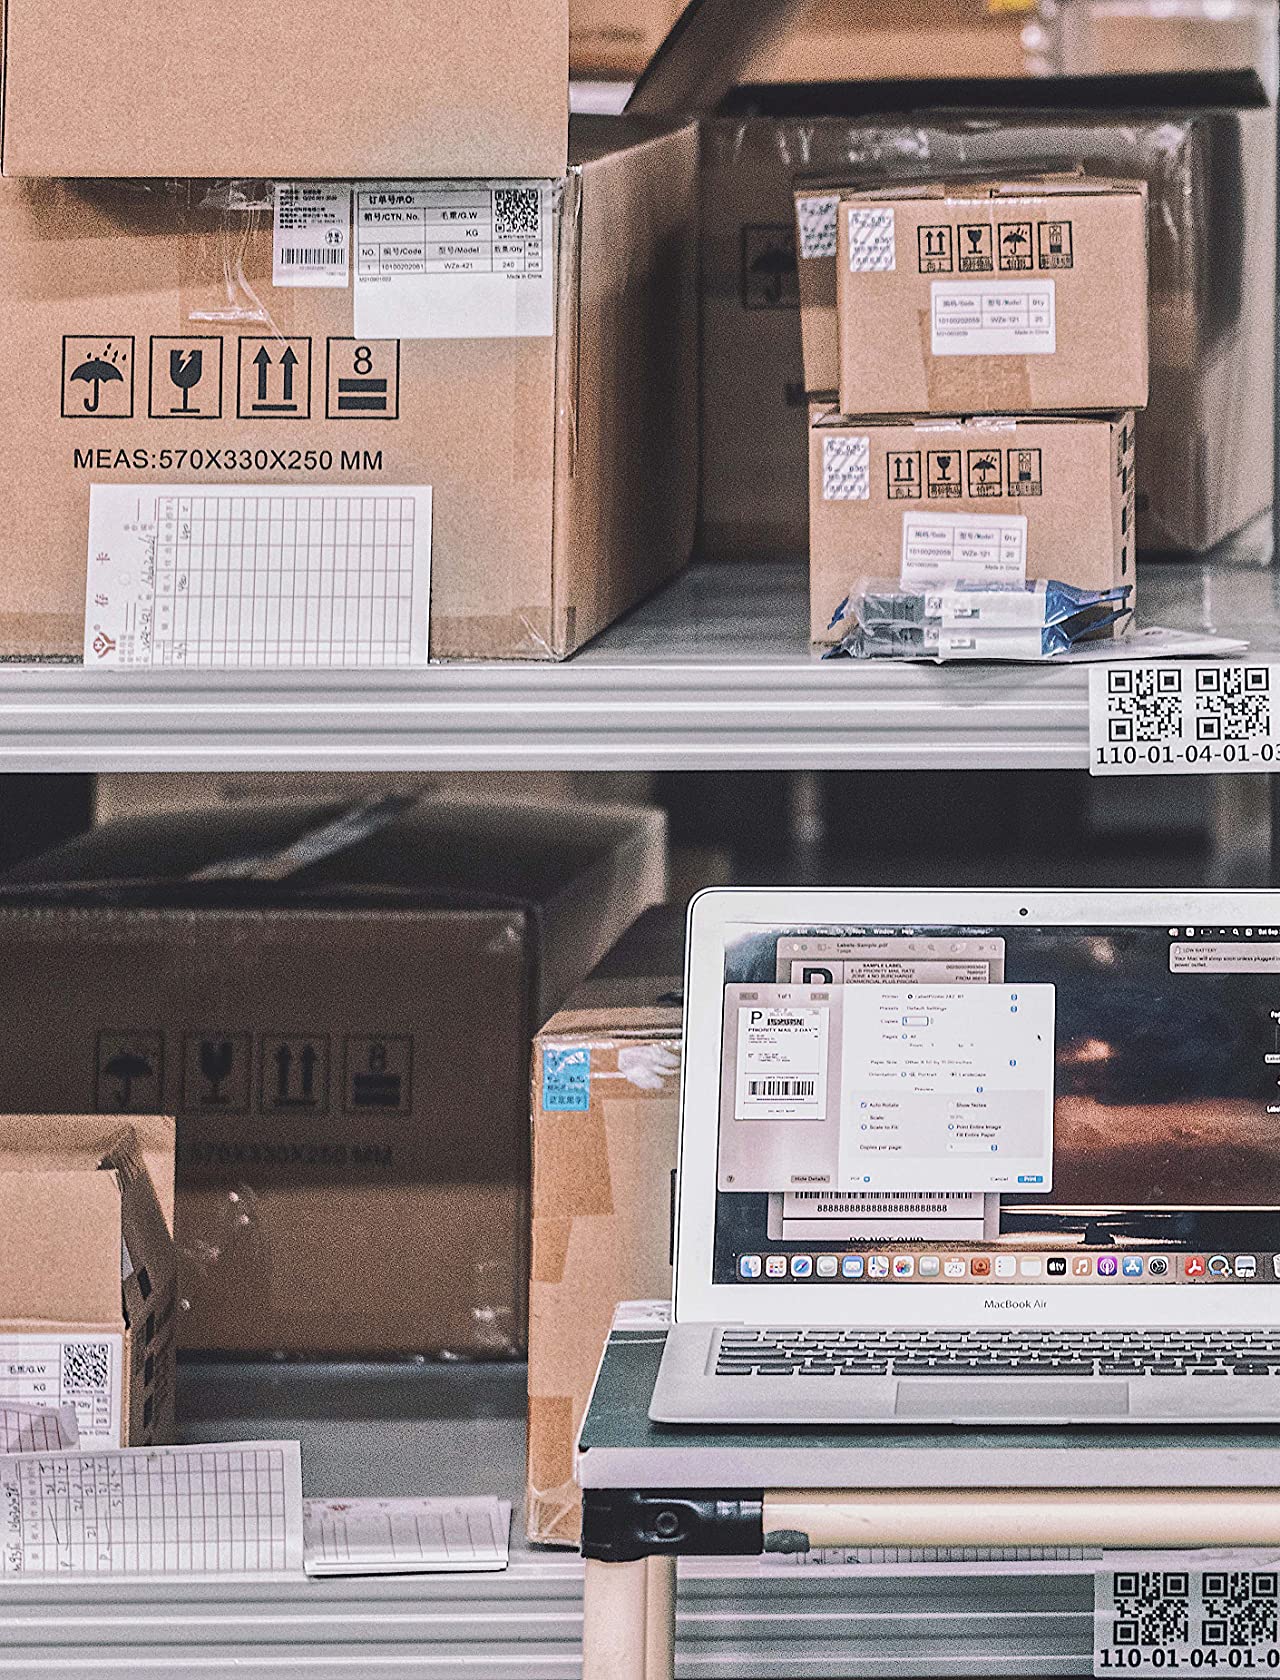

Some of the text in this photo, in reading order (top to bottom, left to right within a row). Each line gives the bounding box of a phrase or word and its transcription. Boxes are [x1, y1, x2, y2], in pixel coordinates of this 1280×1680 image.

[465, 229, 479, 237] KG
[353, 346, 373, 376] 8
[73, 449, 384, 470] MEAS:570X330X250 MM
[751, 1010, 763, 1025] P
[984, 1299, 1047, 1309] MacBook Air
[33, 1383, 46, 1391] KG
